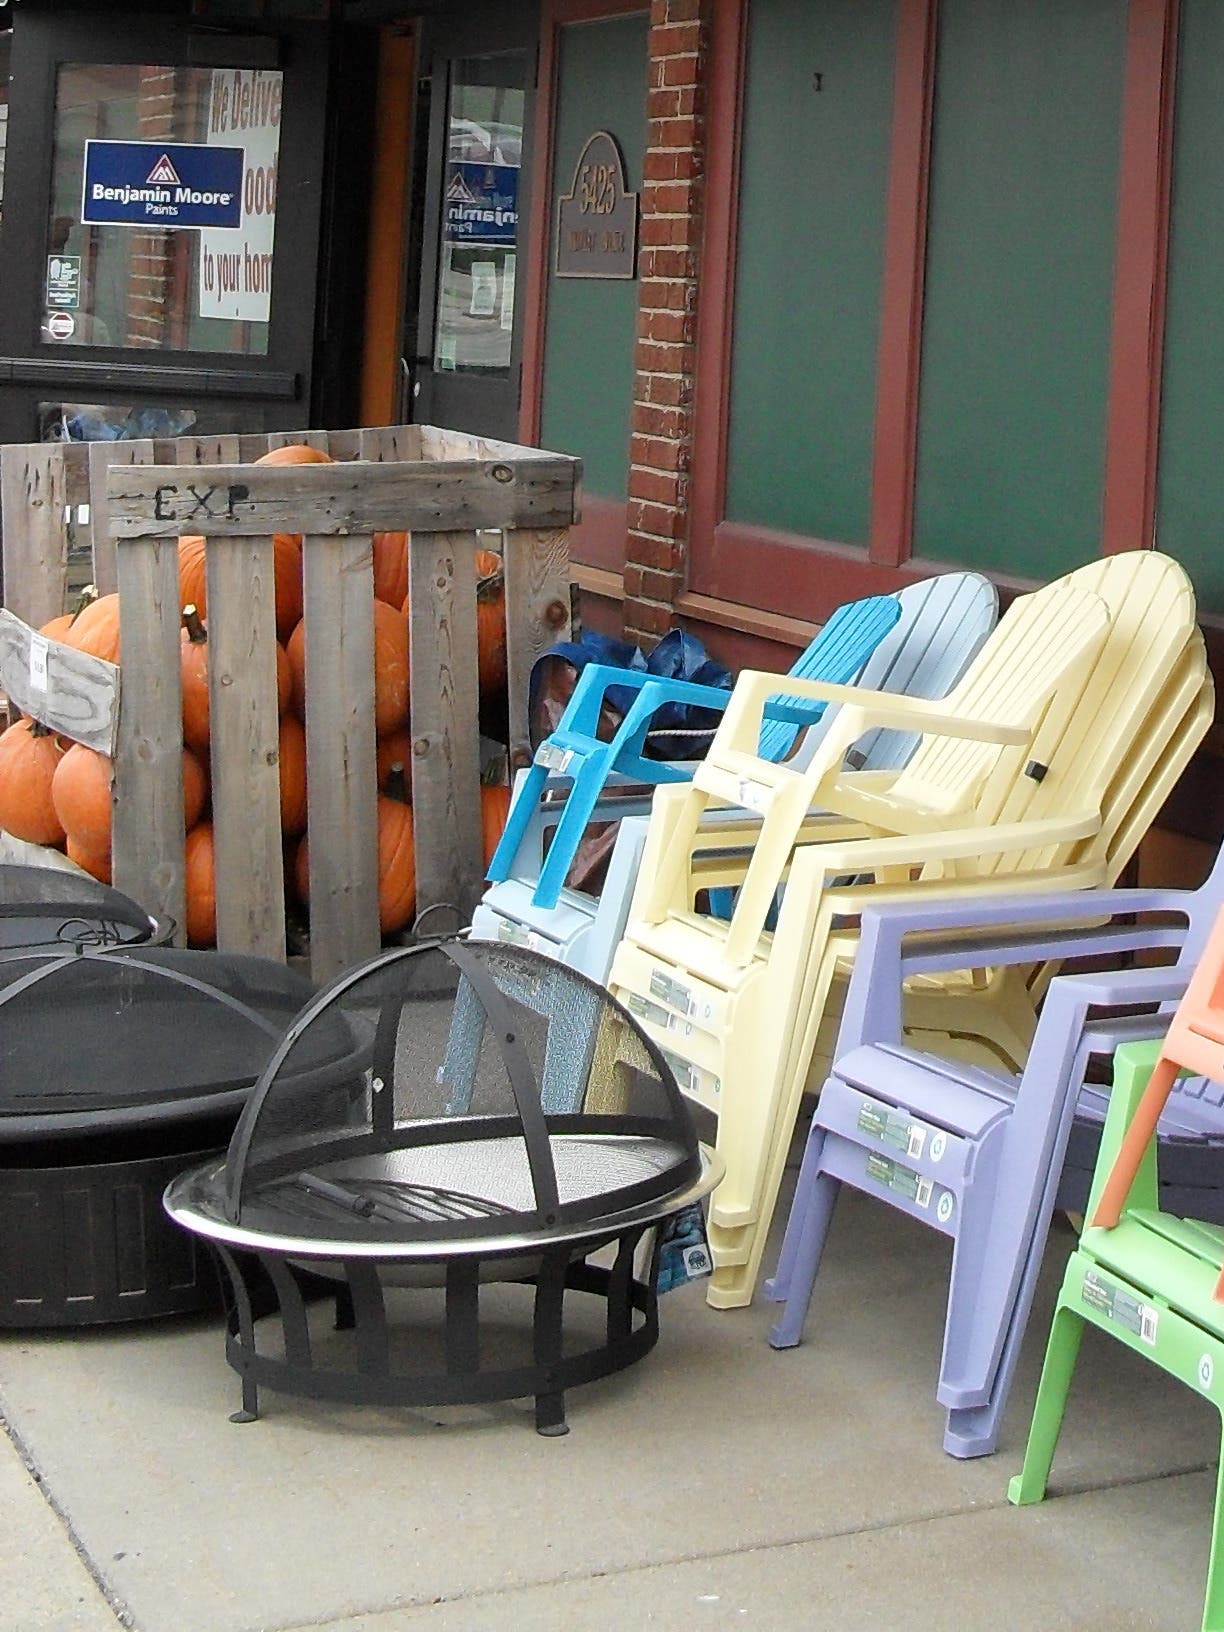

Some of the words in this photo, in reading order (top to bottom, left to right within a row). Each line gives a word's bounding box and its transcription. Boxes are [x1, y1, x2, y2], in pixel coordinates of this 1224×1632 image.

[211, 74, 229, 134] We
[92, 183, 171, 205] Benjamin
[174, 187, 233, 206] Moore
[145, 203, 179, 216] Paints
[579, 164, 616, 215] 5425
[203, 243, 214, 292] to
[216, 253, 242, 303] your
[154, 484, 250, 521] EXP
